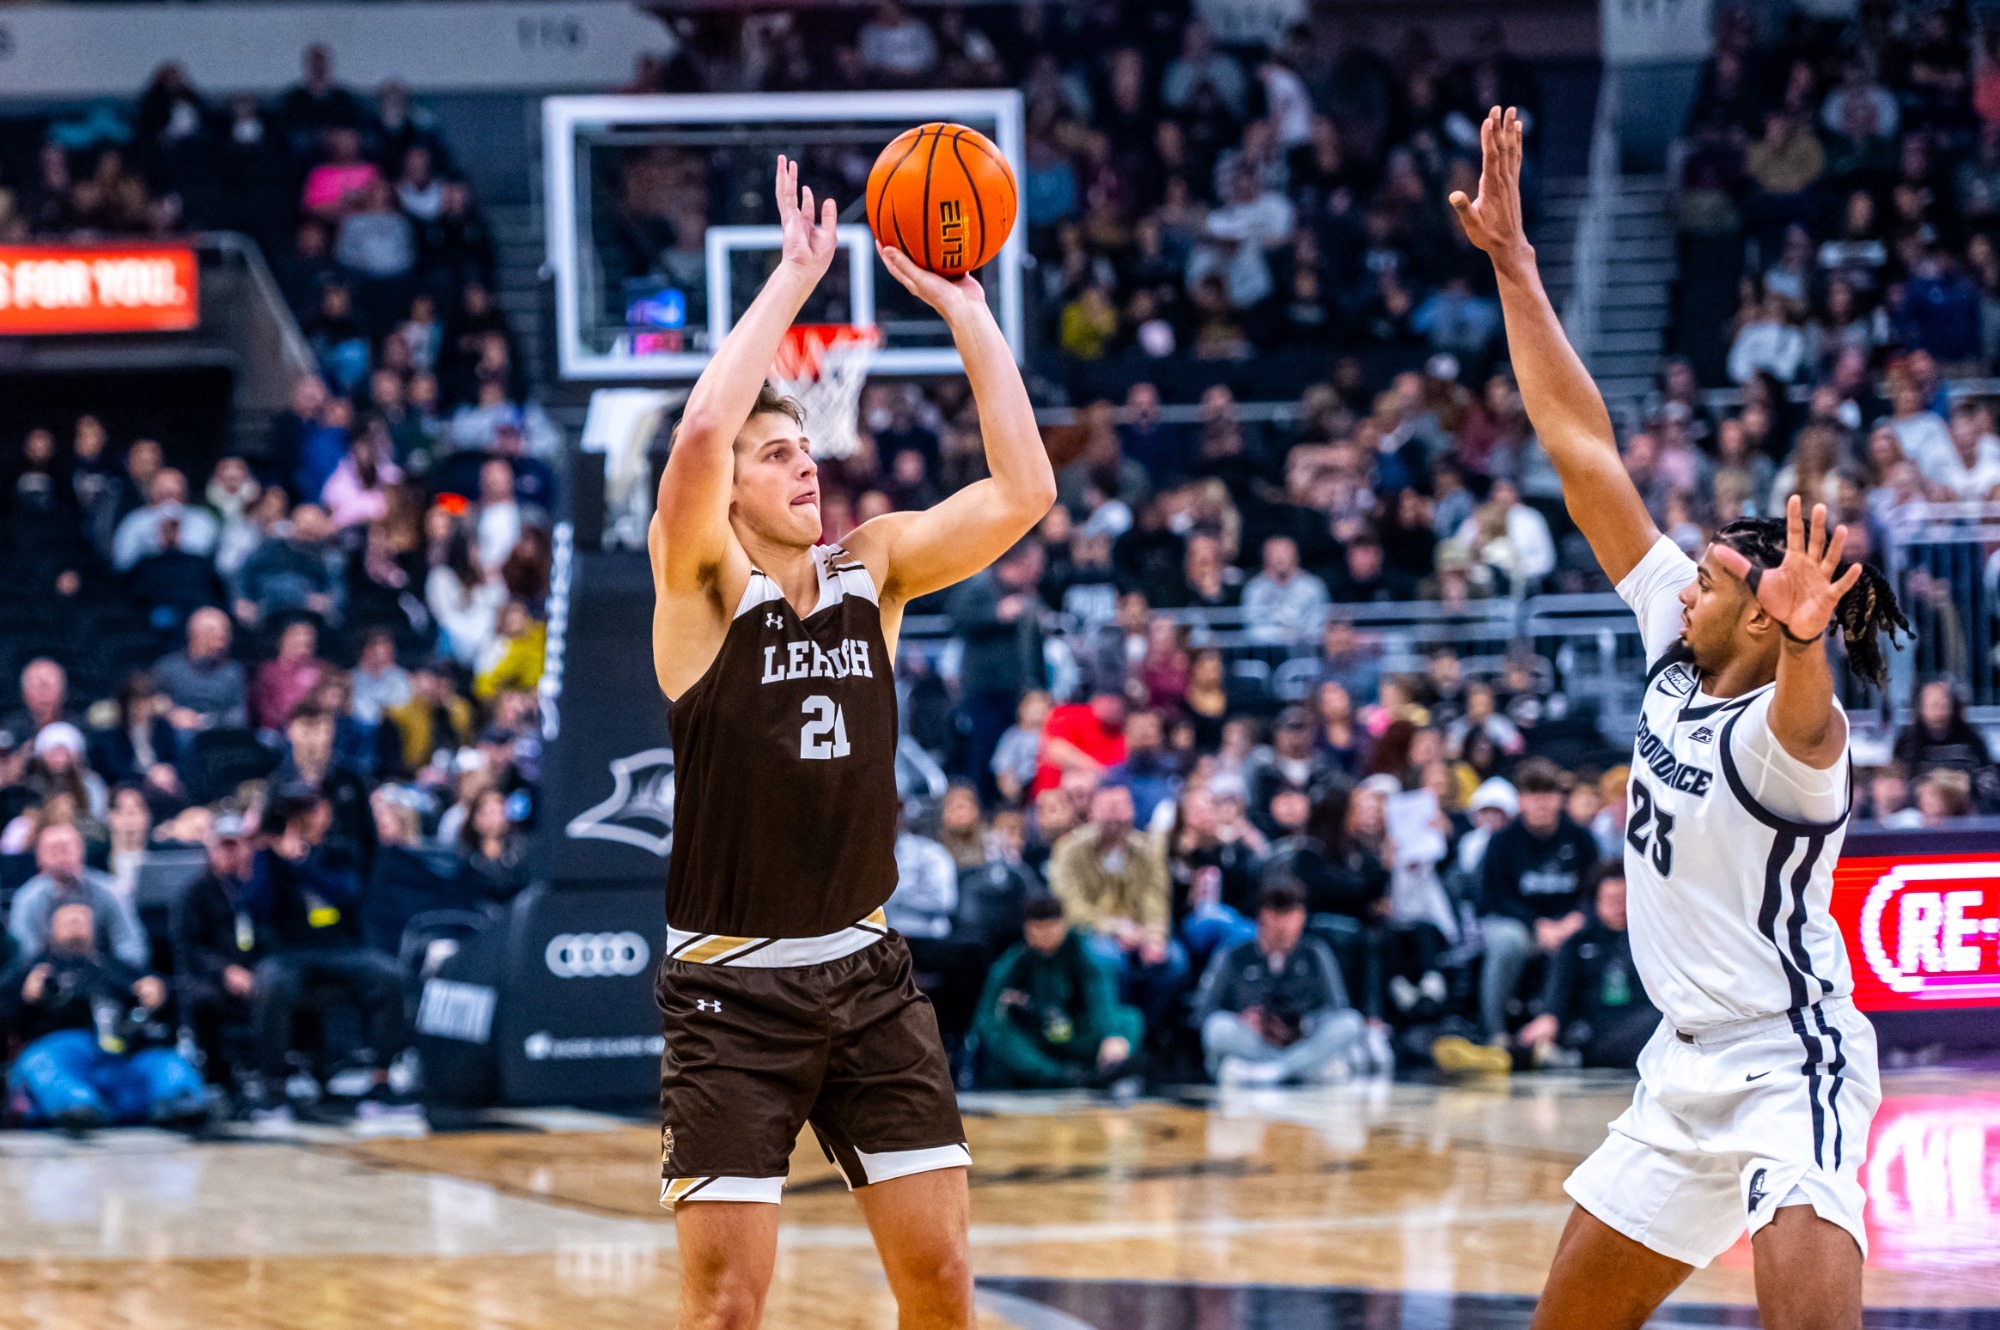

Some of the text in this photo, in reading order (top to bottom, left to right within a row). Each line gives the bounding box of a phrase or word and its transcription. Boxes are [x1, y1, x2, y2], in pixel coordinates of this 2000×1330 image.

[940, 200, 962, 269] ELITE
[13, 259, 91, 310] FOR
[800, 694, 851, 760] 21
[1637, 710, 1713, 797] PROVIDCE
[1626, 777, 1675, 878] 23
